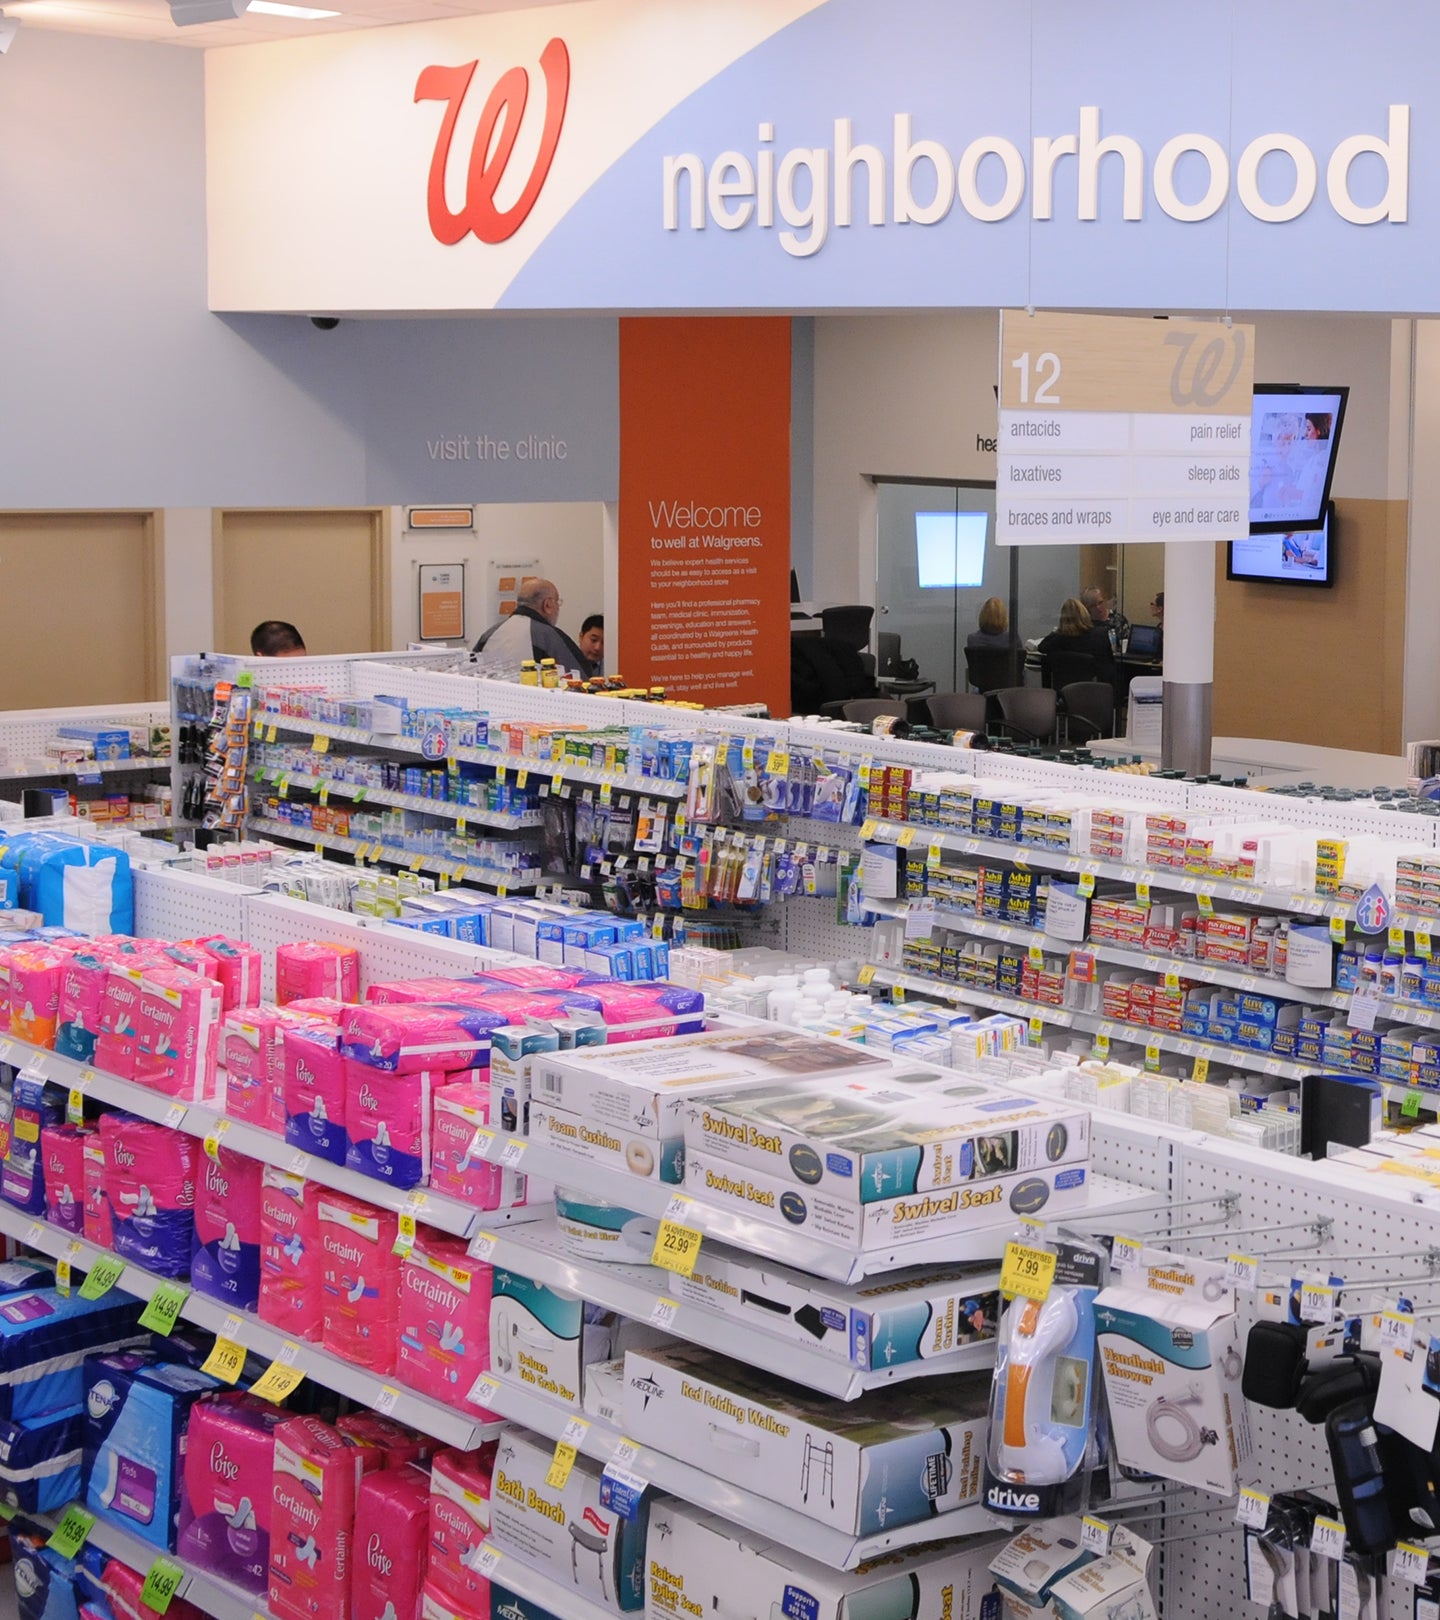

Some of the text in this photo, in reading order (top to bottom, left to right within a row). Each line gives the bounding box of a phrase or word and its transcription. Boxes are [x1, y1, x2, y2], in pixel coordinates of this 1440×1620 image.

[663, 105, 1410, 256] neighborhood
[1012, 352, 1061, 404] 12
[1011, 420, 1061, 436] antacids
[1190, 423, 1242, 442] pain relief
[428, 435, 568, 460] visit the clinic
[1010, 465, 1061, 481] laxatives
[1188, 465, 1240, 484] sleep aids
[648, 500, 761, 528] Welcome
[1008, 509, 1112, 527] braces and wraps
[1152, 508, 1240, 527] eye and ear care
[651, 535, 762, 550] to well at Walgreens.
[140, 1000, 175, 1028] Certainty
[296, 1058, 315, 1086] Poise
[359, 1084, 379, 1111] Poise
[548, 1116, 621, 1152] Foam Cushion
[702, 1111, 783, 1155] Swivel Seat
[114, 1140, 135, 1167] Poise
[206, 1162, 228, 1197] Poise
[706, 1170, 775, 1209] Swivel Seat
[263, 1200, 298, 1228] Certainty
[892, 1185, 1002, 1223] Swivel Seat
[663, 1223, 699, 1241] AS ADVERTISED
[663, 1235, 689, 1254] 22.99
[323, 1235, 364, 1267] Certainty
[1011, 1246, 1052, 1265] AS ADVERTISED
[1073, 1253, 1095, 1264] drive
[1016, 1257, 1039, 1276] 7.99
[1148, 1268, 1195, 1286] Handheld
[406, 1269, 461, 1316] Certainty
[1148, 1278, 1185, 1295] Shower
[518, 1352, 548, 1374] Deluxe
[1104, 1347, 1165, 1374] Handheld
[1107, 1363, 1154, 1386] Shower
[519, 1368, 575, 1402] Tub Grab Bar
[631, 1378, 664, 1399] MEDLINE
[681, 1381, 790, 1438] Red Folding Walker
[210, 1441, 239, 1480] Poise
[273, 1485, 321, 1530] Certainty
[496, 1470, 565, 1526] Bath Bench
[988, 1487, 1040, 1508] drive
[435, 1503, 474, 1539] Certainty
[334, 1530, 348, 1580] Certainty
[367, 1533, 392, 1576] Poise
[651, 1561, 683, 1590] Raised
[650, 1579, 703, 1618] Toilet Seat
